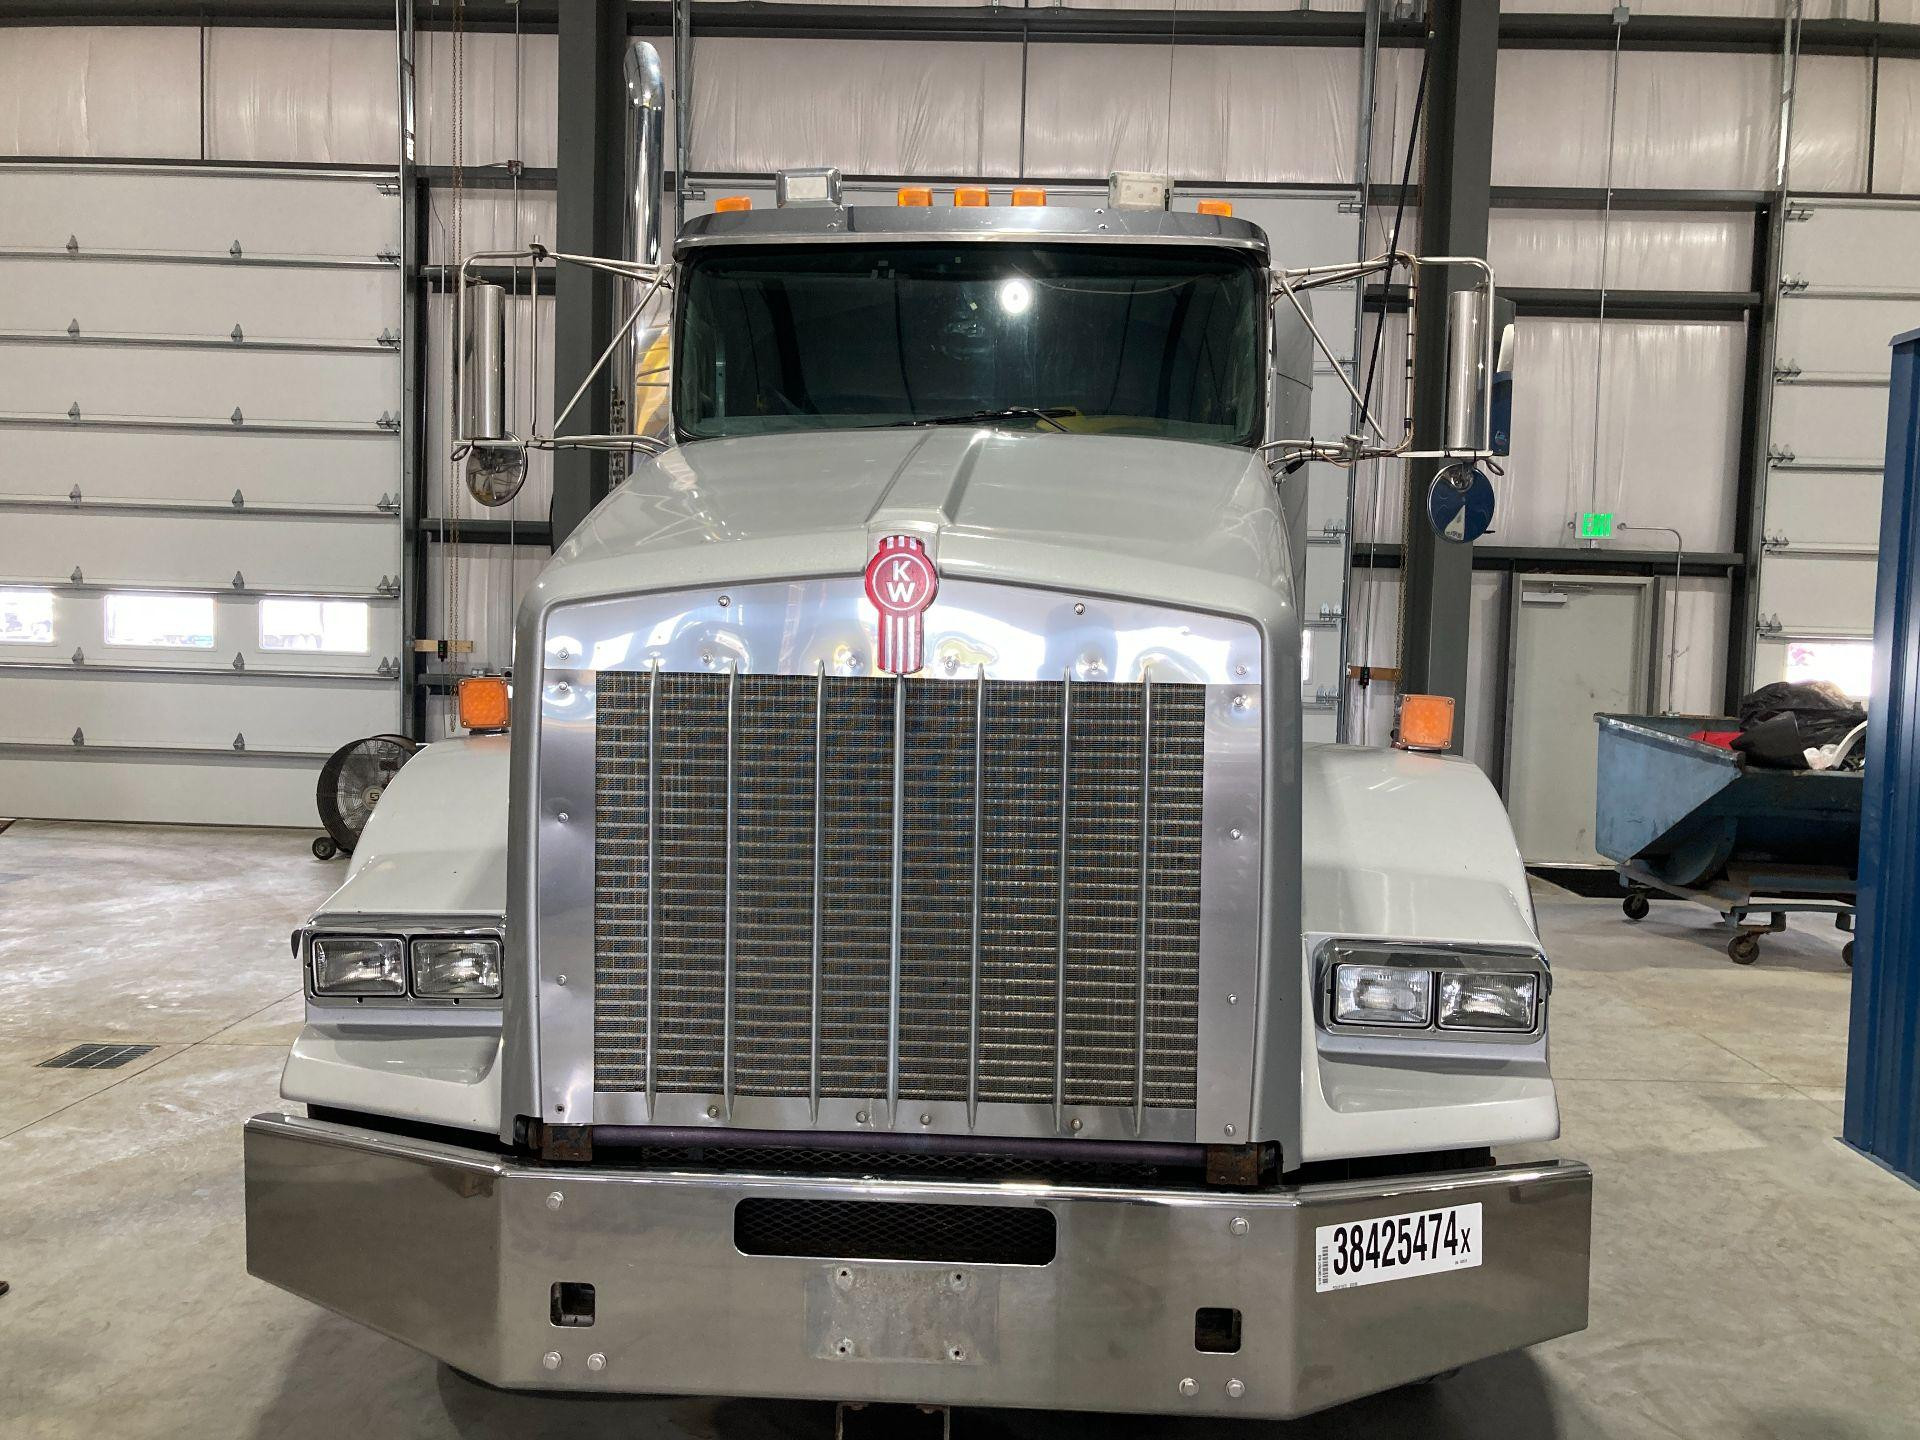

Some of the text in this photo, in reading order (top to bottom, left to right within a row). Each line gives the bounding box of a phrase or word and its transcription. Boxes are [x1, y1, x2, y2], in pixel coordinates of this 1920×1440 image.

[1582, 513, 1613, 537] EXIT
[892, 560, 911, 582] K
[886, 582, 916, 603] W
[1333, 1210, 1459, 1276] 38425474
